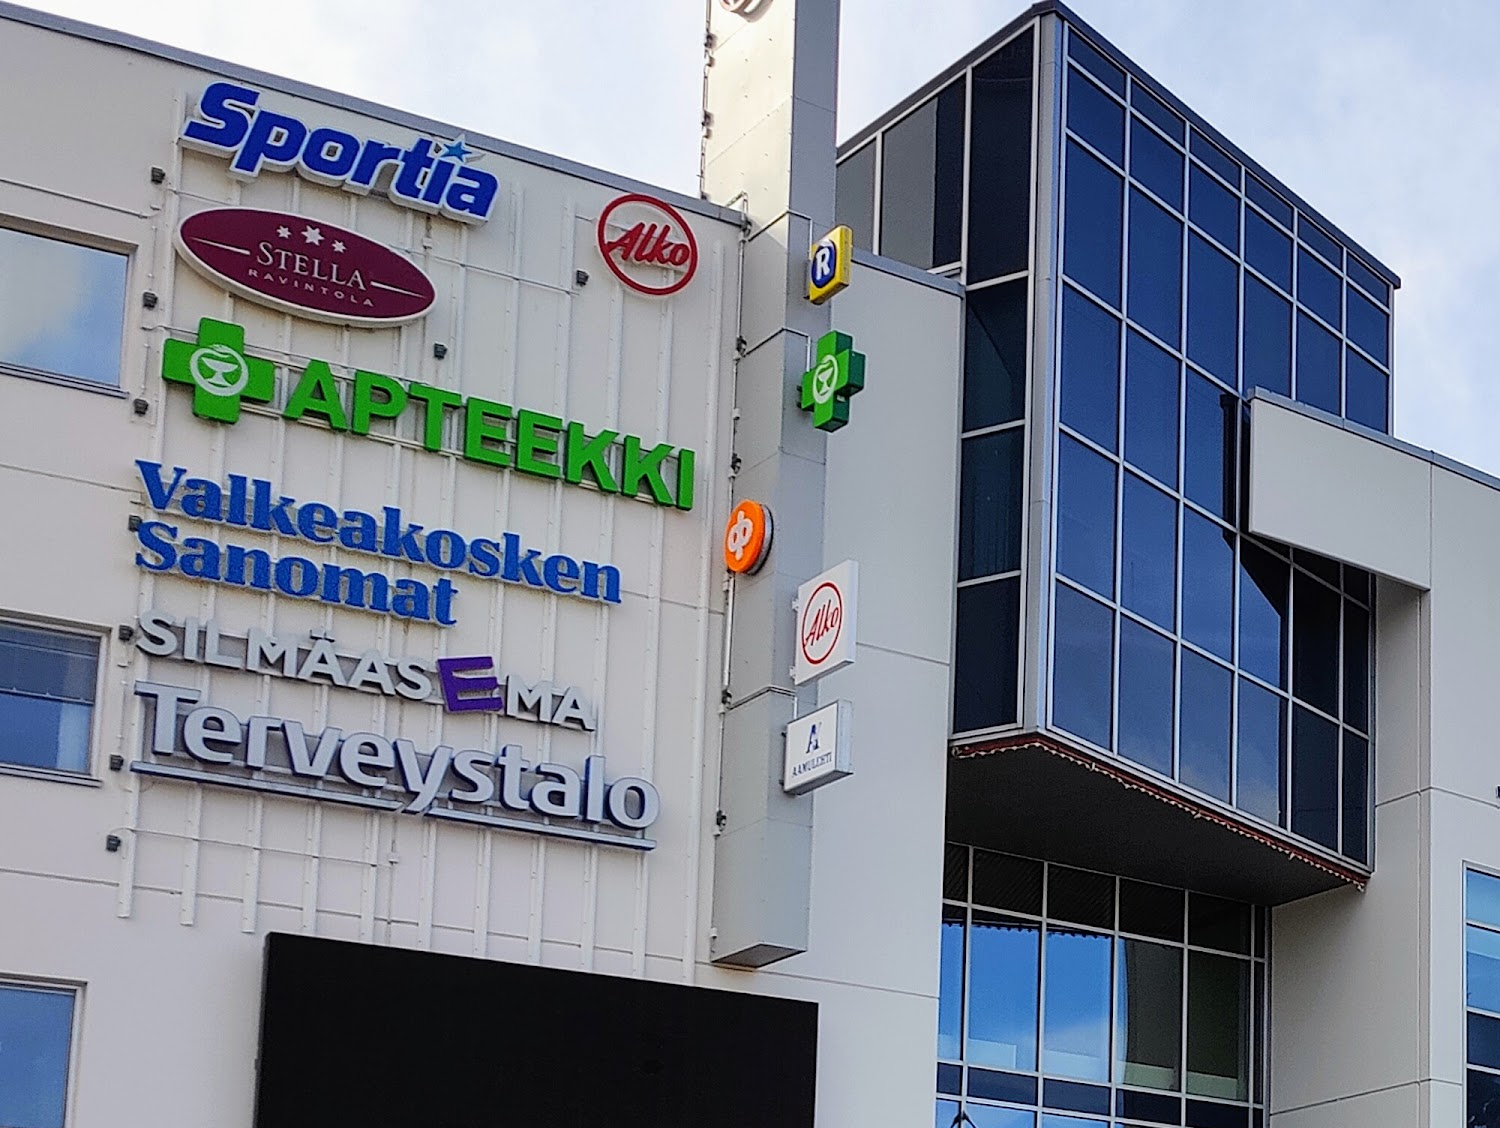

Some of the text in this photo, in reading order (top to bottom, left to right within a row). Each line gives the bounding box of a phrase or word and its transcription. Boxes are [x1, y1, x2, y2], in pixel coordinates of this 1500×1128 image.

[182, 80, 499, 226] Sportia
[248, 268, 374, 307] RAVINTOLA
[257, 241, 367, 291] STELLA
[605, 222, 691, 266] Alko
[282, 359, 695, 510] APTEEKKI
[135, 459, 621, 604] Valkeakosken
[135, 518, 457, 627] Sanomat
[136, 609, 596, 732] SILMÄASEMA
[804, 599, 839, 647] Alko
[133, 680, 660, 830] Terveystalo
